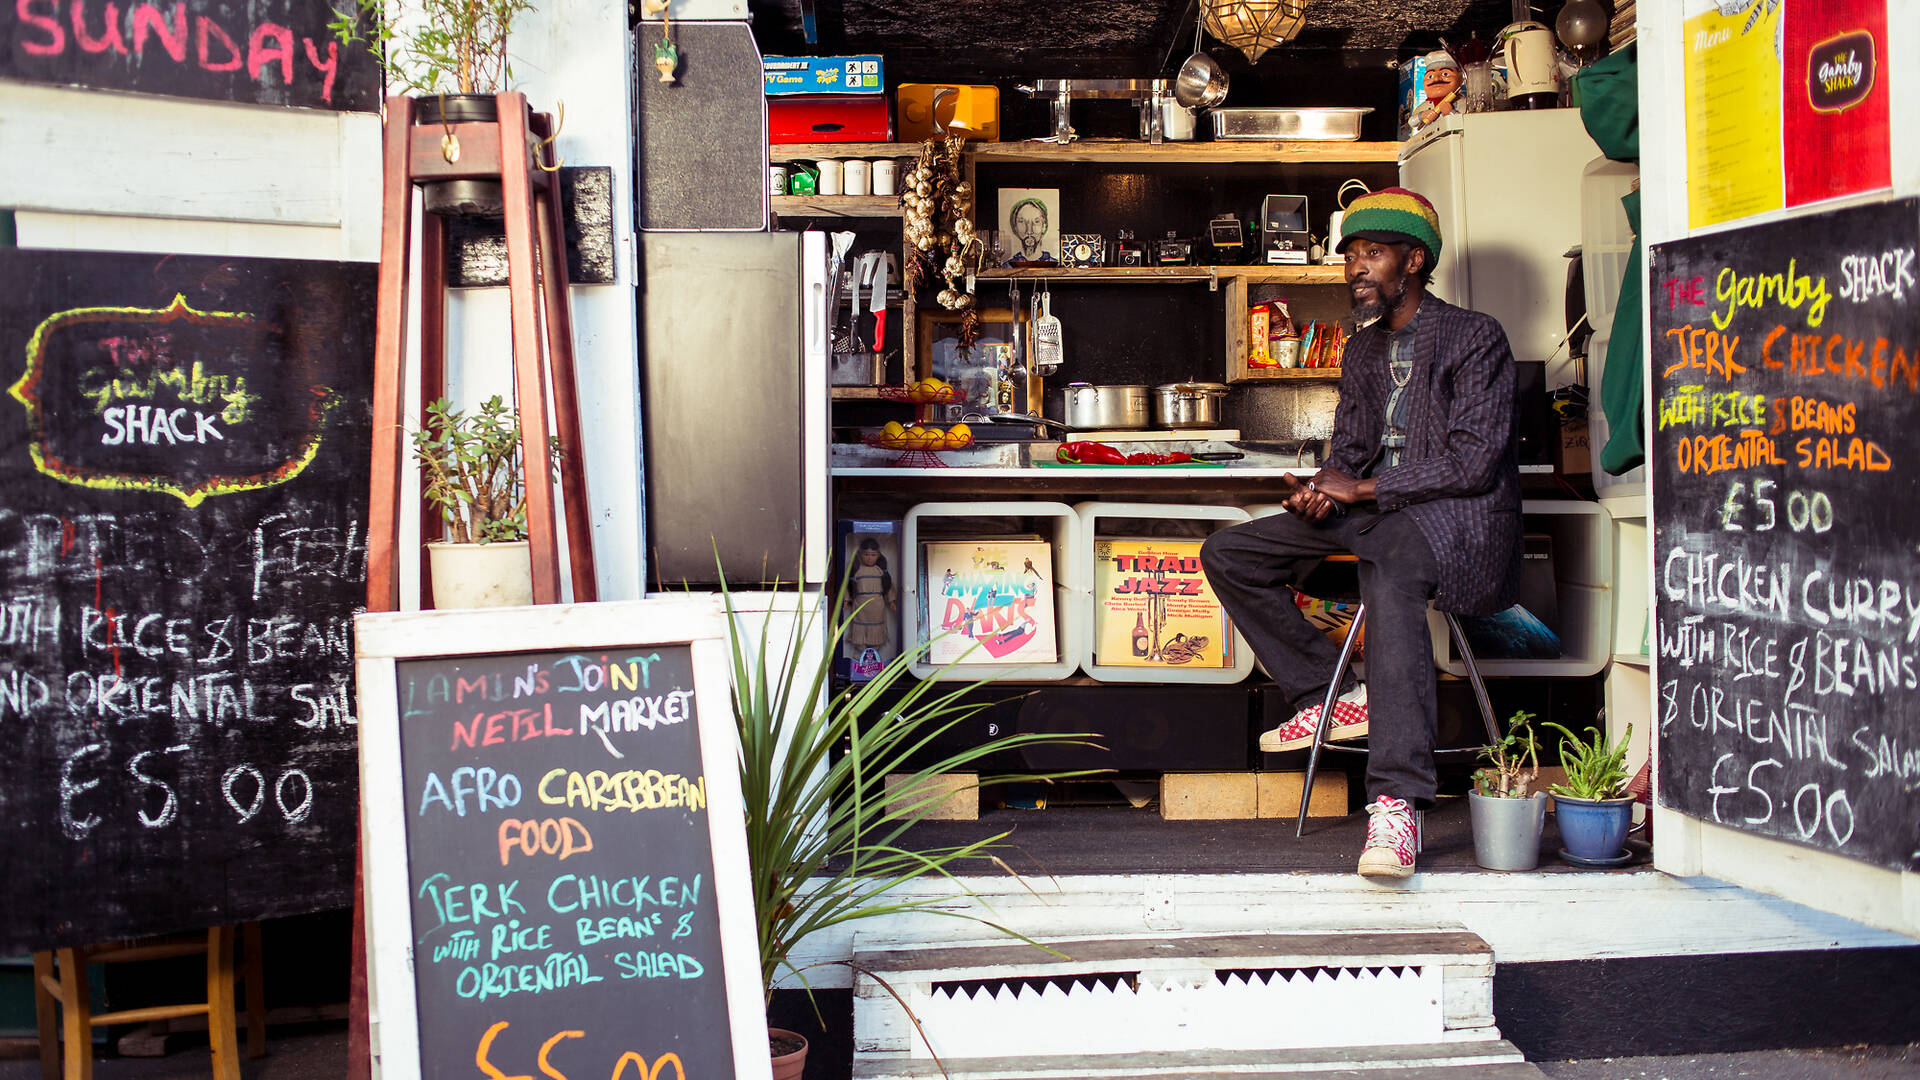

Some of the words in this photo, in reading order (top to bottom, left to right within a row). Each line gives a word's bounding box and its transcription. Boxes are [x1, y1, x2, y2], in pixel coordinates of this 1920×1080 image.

[1693, 26, 1732, 52] Menu
[1824, 75, 1854, 94] SHACK
[1662, 276, 1706, 310] THE
[1839, 248, 1916, 303] SHACK
[1663, 325, 1747, 381] JERK
[1762, 325, 1920, 393] CHICKEN
[102, 404, 223, 446] SHACK
[1658, 384, 1706, 431] WITH
[1711, 391, 1766, 428] RICE
[1791, 395, 1857, 434] BEANS
[1678, 430, 1787, 475] ORIENTAL
[1796, 438, 1892, 471] SALAD
[1112, 555, 1203, 573] TRAD
[1114, 577, 1204, 596] JAZZ
[1664, 546, 1791, 622] CHICKEN
[1802, 570, 1920, 643] CURRY
[80, 604, 192, 658] RICE
[248, 615, 356, 664] BEAN
[1660, 615, 1715, 671] WITH
[1722, 622, 1781, 681] RICE
[1814, 628, 1918, 697] BEANS
[65, 670, 278, 727] ORIENTAL
[451, 702, 574, 751] NETIL
[579, 689, 695, 757] MARKET
[1690, 682, 1848, 770] ORIENTAL
[419, 766, 522, 817] AFRO
[538, 768, 706, 812] CARIBBEAN
[499, 817, 593, 867] FOOD
[418, 872, 526, 944] JERK
[547, 873, 702, 913] CHICKEN
[456, 951, 604, 1003] ORIENTAL
[614, 952, 704, 979] SALAD
